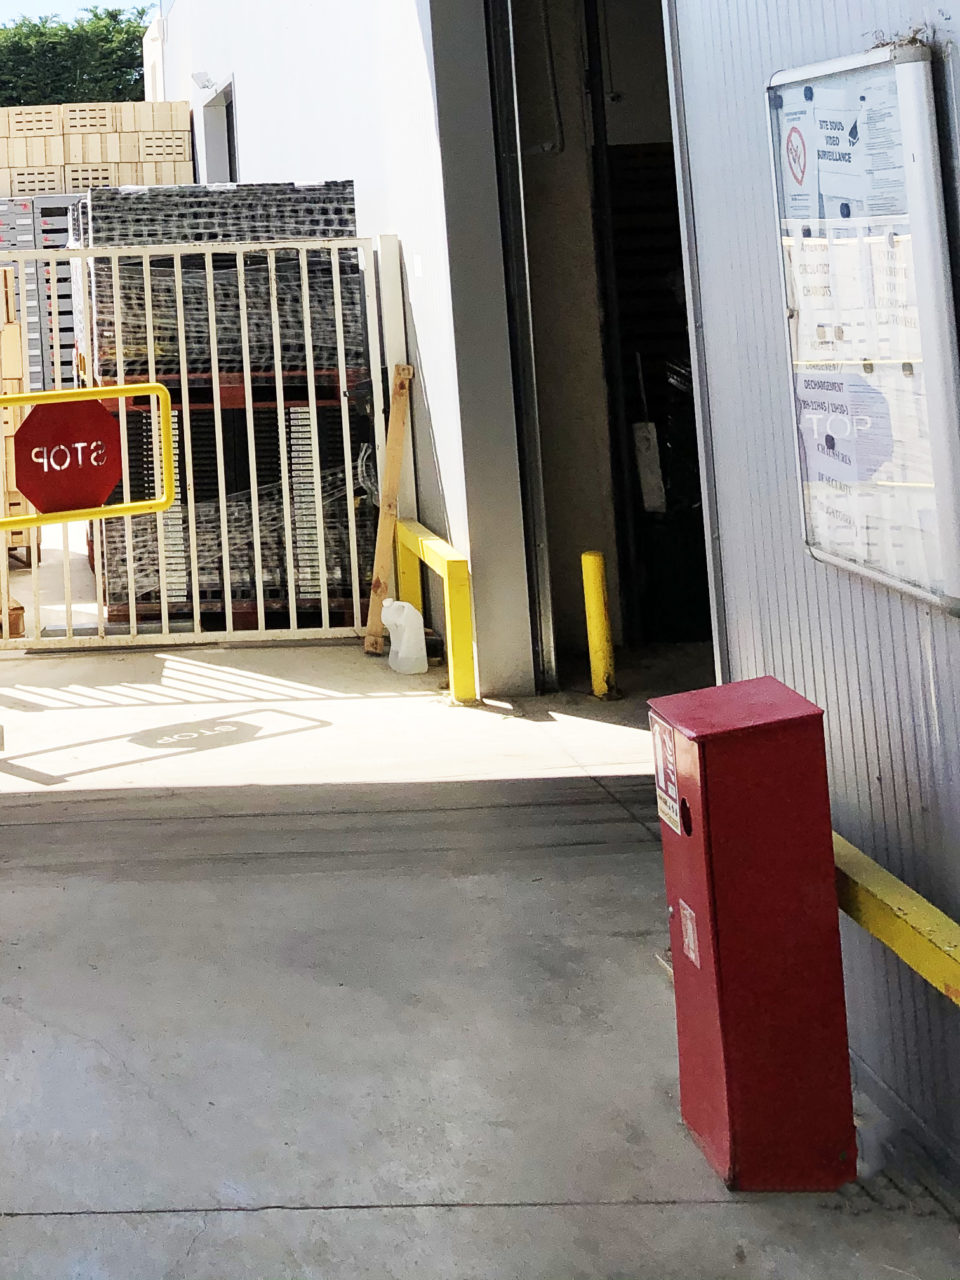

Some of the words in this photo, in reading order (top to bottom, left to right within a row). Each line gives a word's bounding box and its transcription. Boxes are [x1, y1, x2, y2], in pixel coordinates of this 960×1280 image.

[818, 119, 829, 131] SITE
[829, 120, 845, 132] SOUS
[817, 149, 852, 163] SURVEILLANCE
[803, 379, 844, 393] DECHARGEMENT
